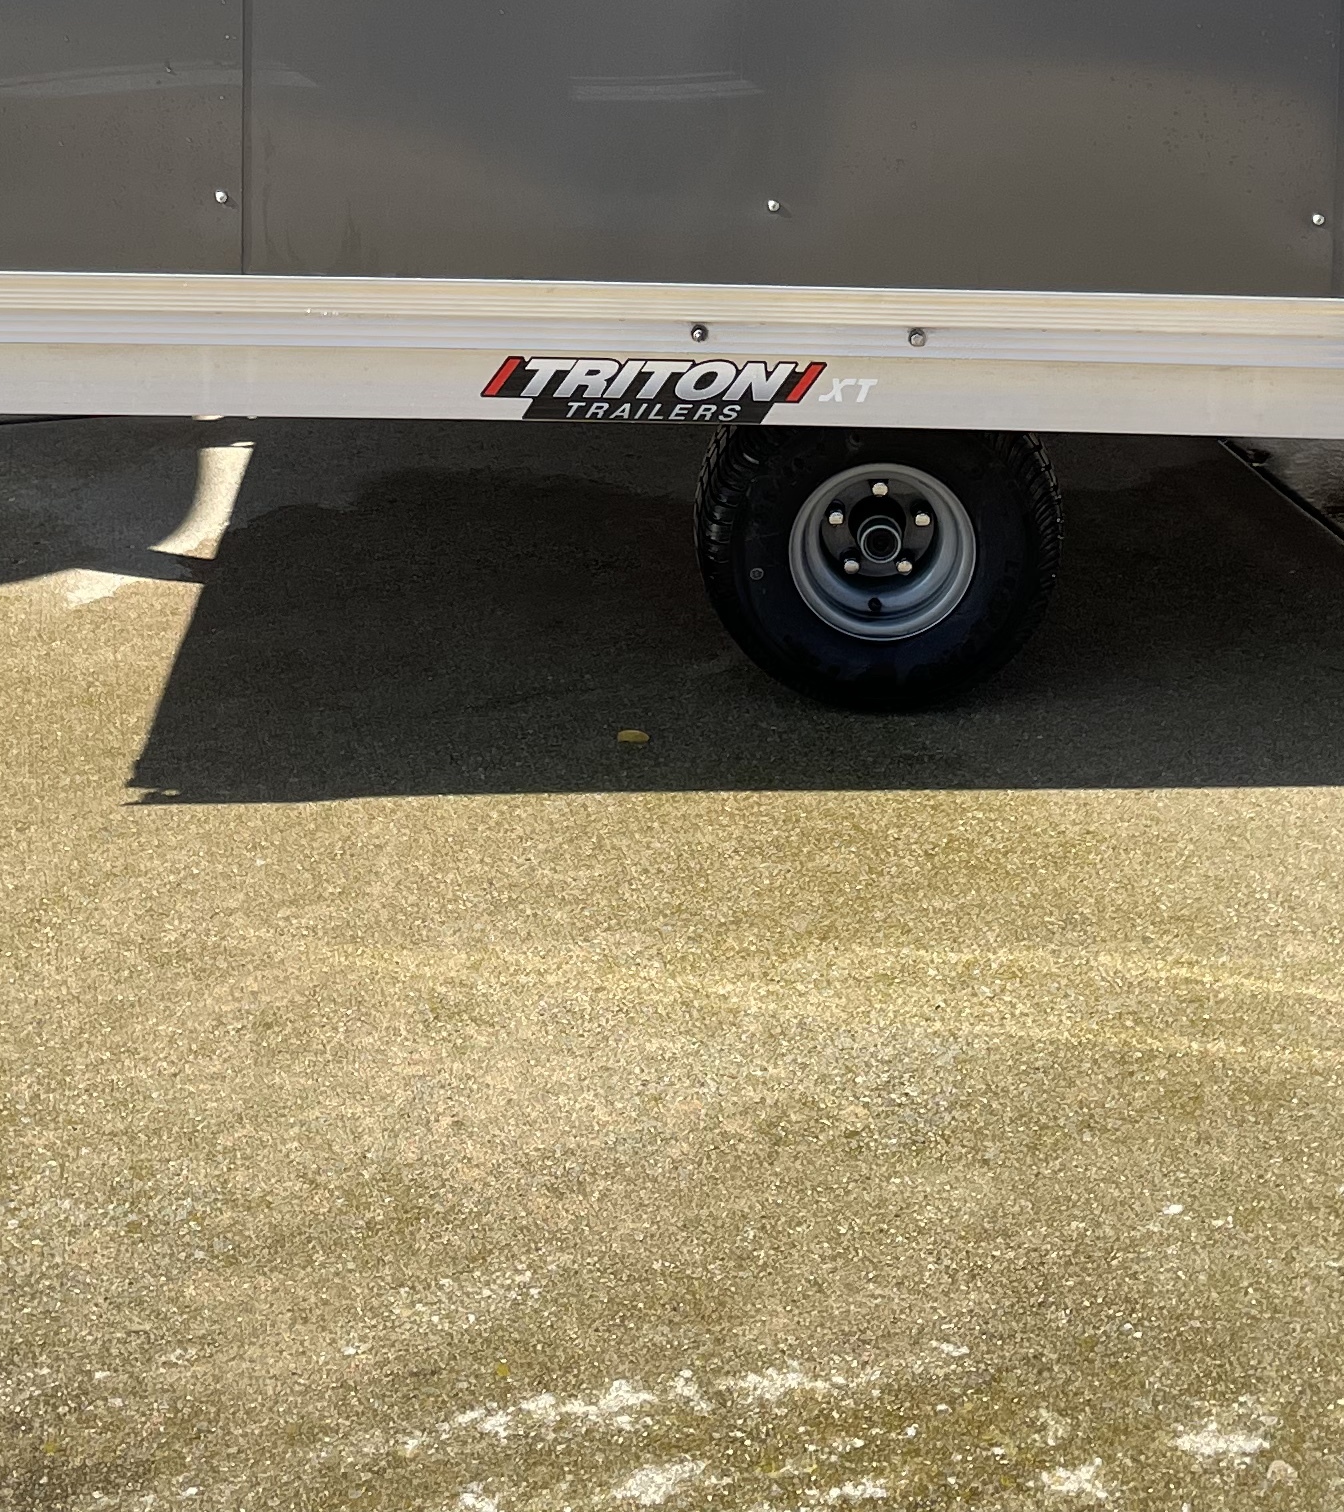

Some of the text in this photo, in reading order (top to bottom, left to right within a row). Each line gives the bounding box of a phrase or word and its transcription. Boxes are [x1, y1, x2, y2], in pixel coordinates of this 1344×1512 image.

[520, 358, 798, 401] TRITON
[818, 378, 879, 403] XT
[565, 401, 742, 421] TRAILERS
